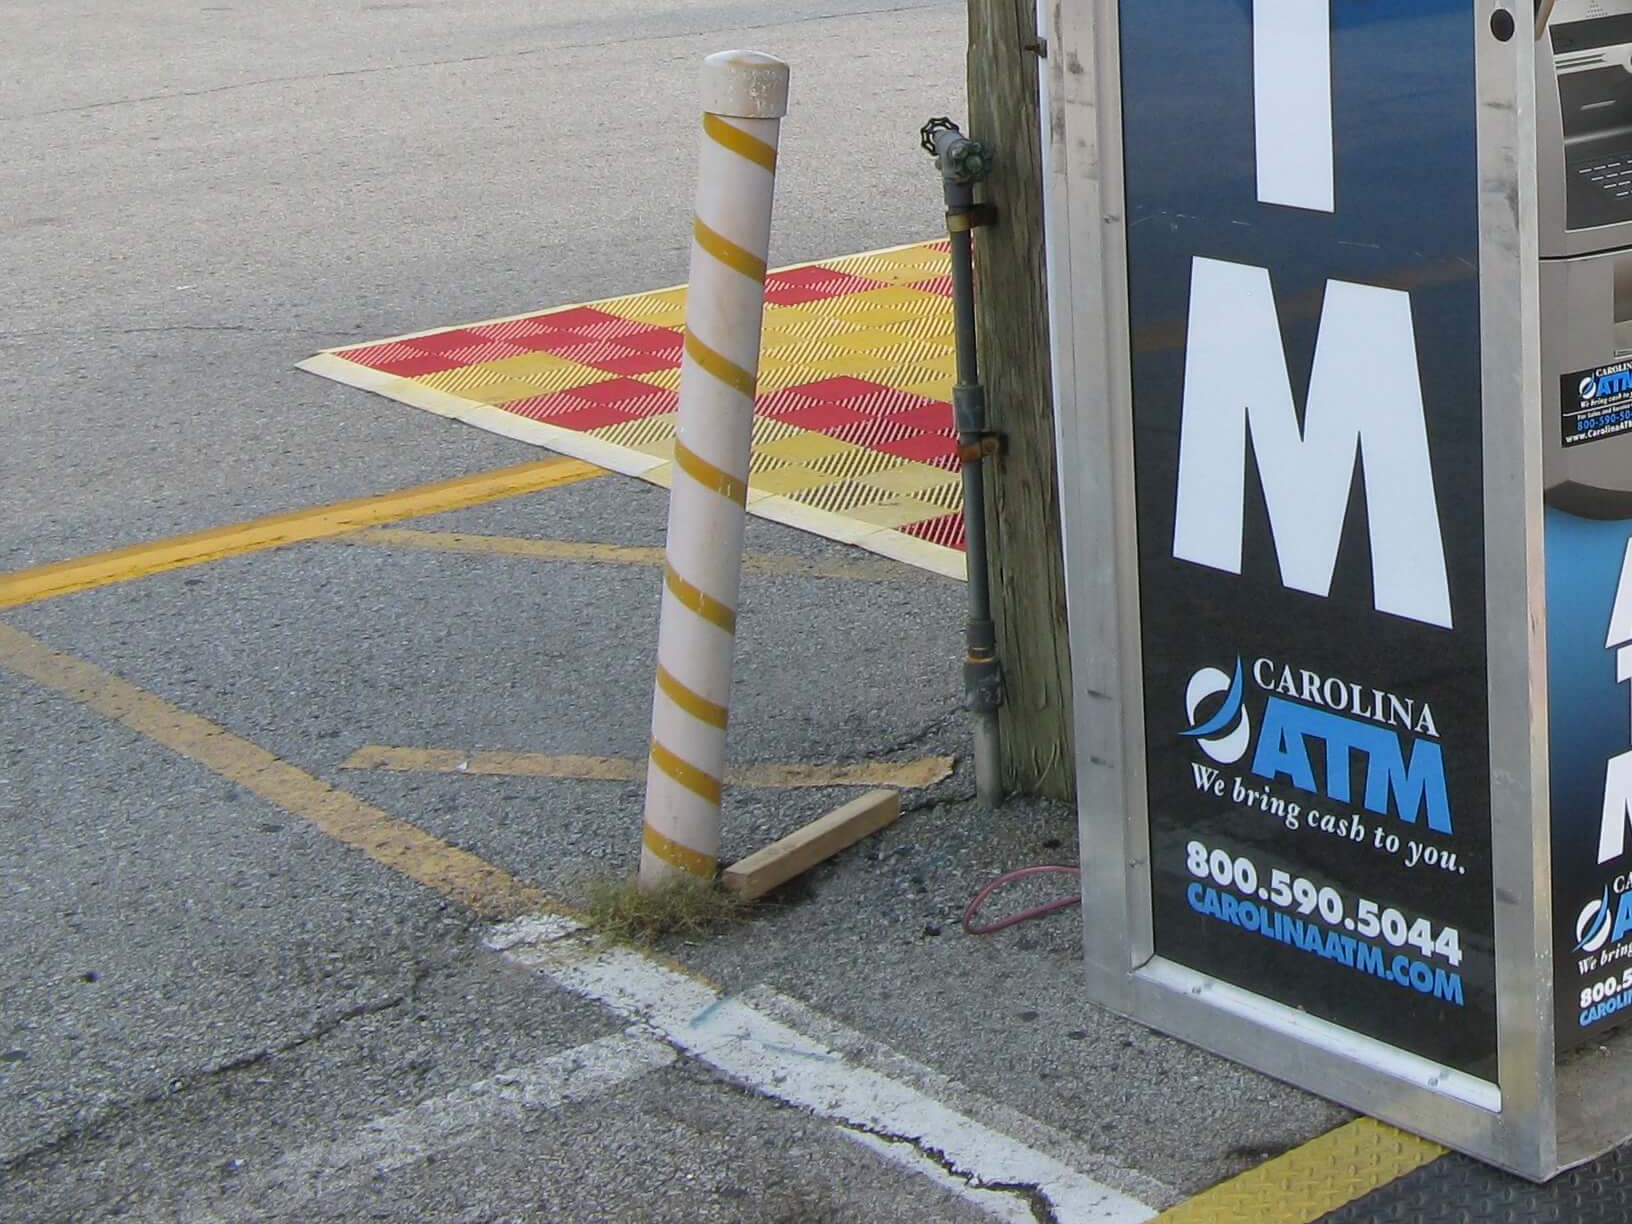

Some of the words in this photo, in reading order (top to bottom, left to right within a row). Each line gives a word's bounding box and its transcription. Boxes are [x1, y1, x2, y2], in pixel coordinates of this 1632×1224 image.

[1253, 657, 1441, 737] CAROLINA
[1191, 762, 1226, 797] We
[1231, 777, 1301, 831] bring
[1307, 809, 1365, 844] cash
[1373, 829, 1400, 855] to
[1404, 840, 1467, 875] you.
[1251, 695, 1454, 835] ATM
[1186, 840, 1463, 967] 800.590.5044
[1186, 882, 1464, 1007] CAROLINAATM.COM
[1578, 955, 1598, 976] We
